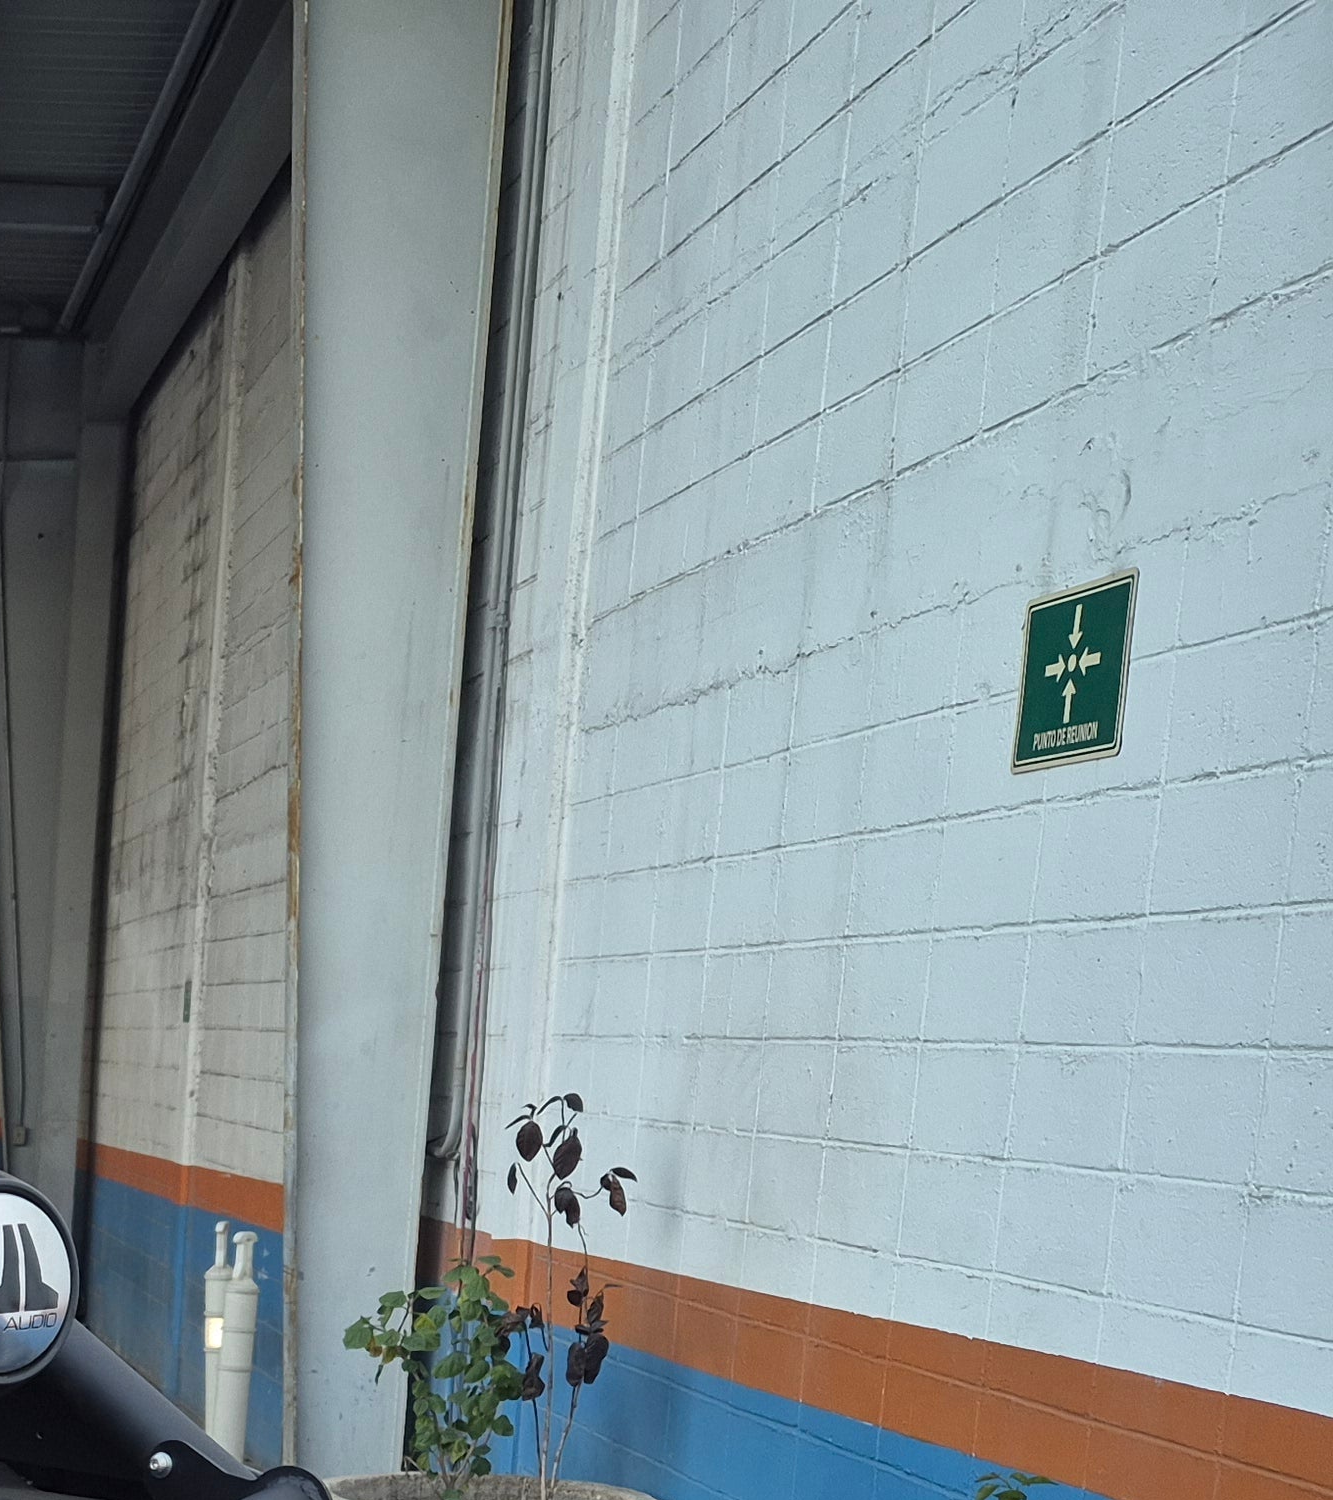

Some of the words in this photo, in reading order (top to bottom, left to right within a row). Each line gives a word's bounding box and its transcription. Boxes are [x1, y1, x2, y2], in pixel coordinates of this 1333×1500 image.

[1032, 729, 1056, 751] PUNTO
[1056, 727, 1067, 747] DE
[1066, 720, 1099, 744] REUNION
[3, 1312, 58, 1331] AUDIO
